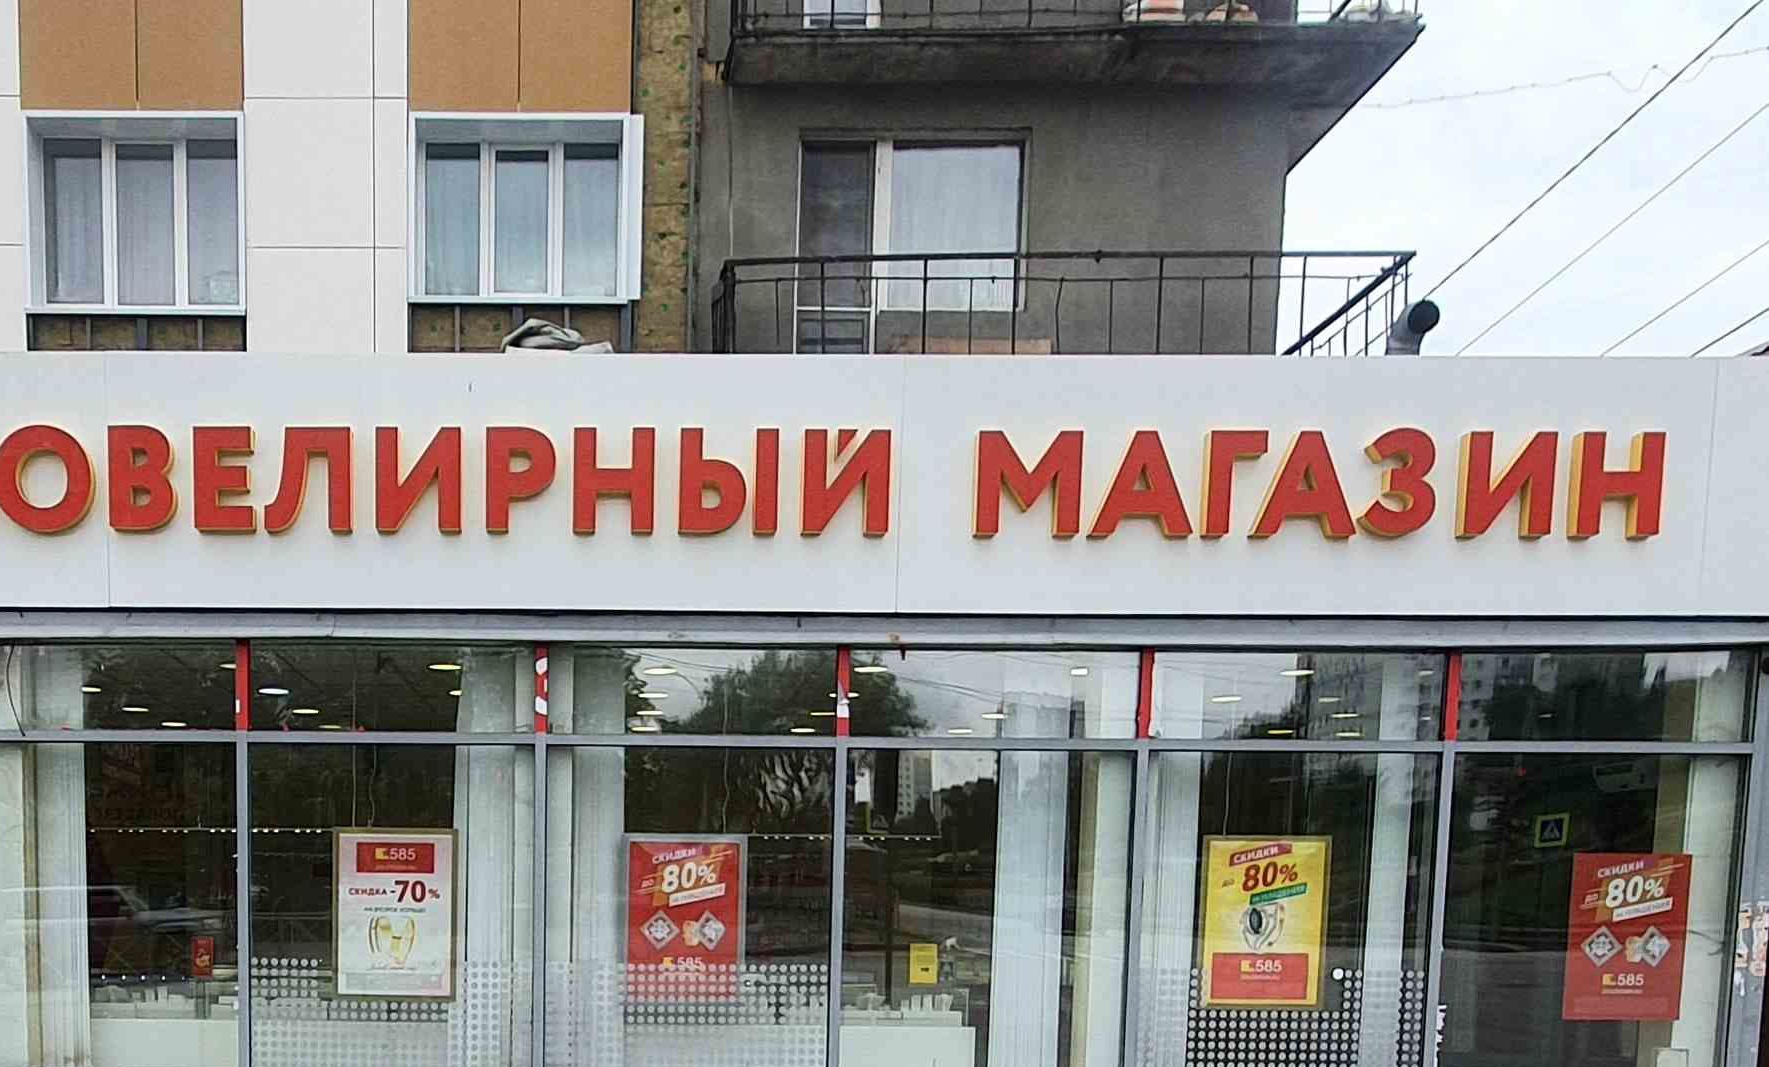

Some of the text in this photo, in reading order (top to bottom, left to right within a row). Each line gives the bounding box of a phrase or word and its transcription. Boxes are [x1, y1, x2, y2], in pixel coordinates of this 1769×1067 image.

[972, 427, 1667, 541] МАГАЗИН
[389, 848, 416, 860] 585
[1233, 845, 1279, 863] СКИДКИ
[661, 861, 717, 893] 80%
[1242, 861, 1298, 892] 80%
[1597, 860, 1644, 878] СКИДКИ
[348, 887, 387, 896] СКИДКА
[1605, 875, 1664, 908] 80%
[1255, 960, 1281, 972] 585
[1617, 974, 1644, 986] 585
